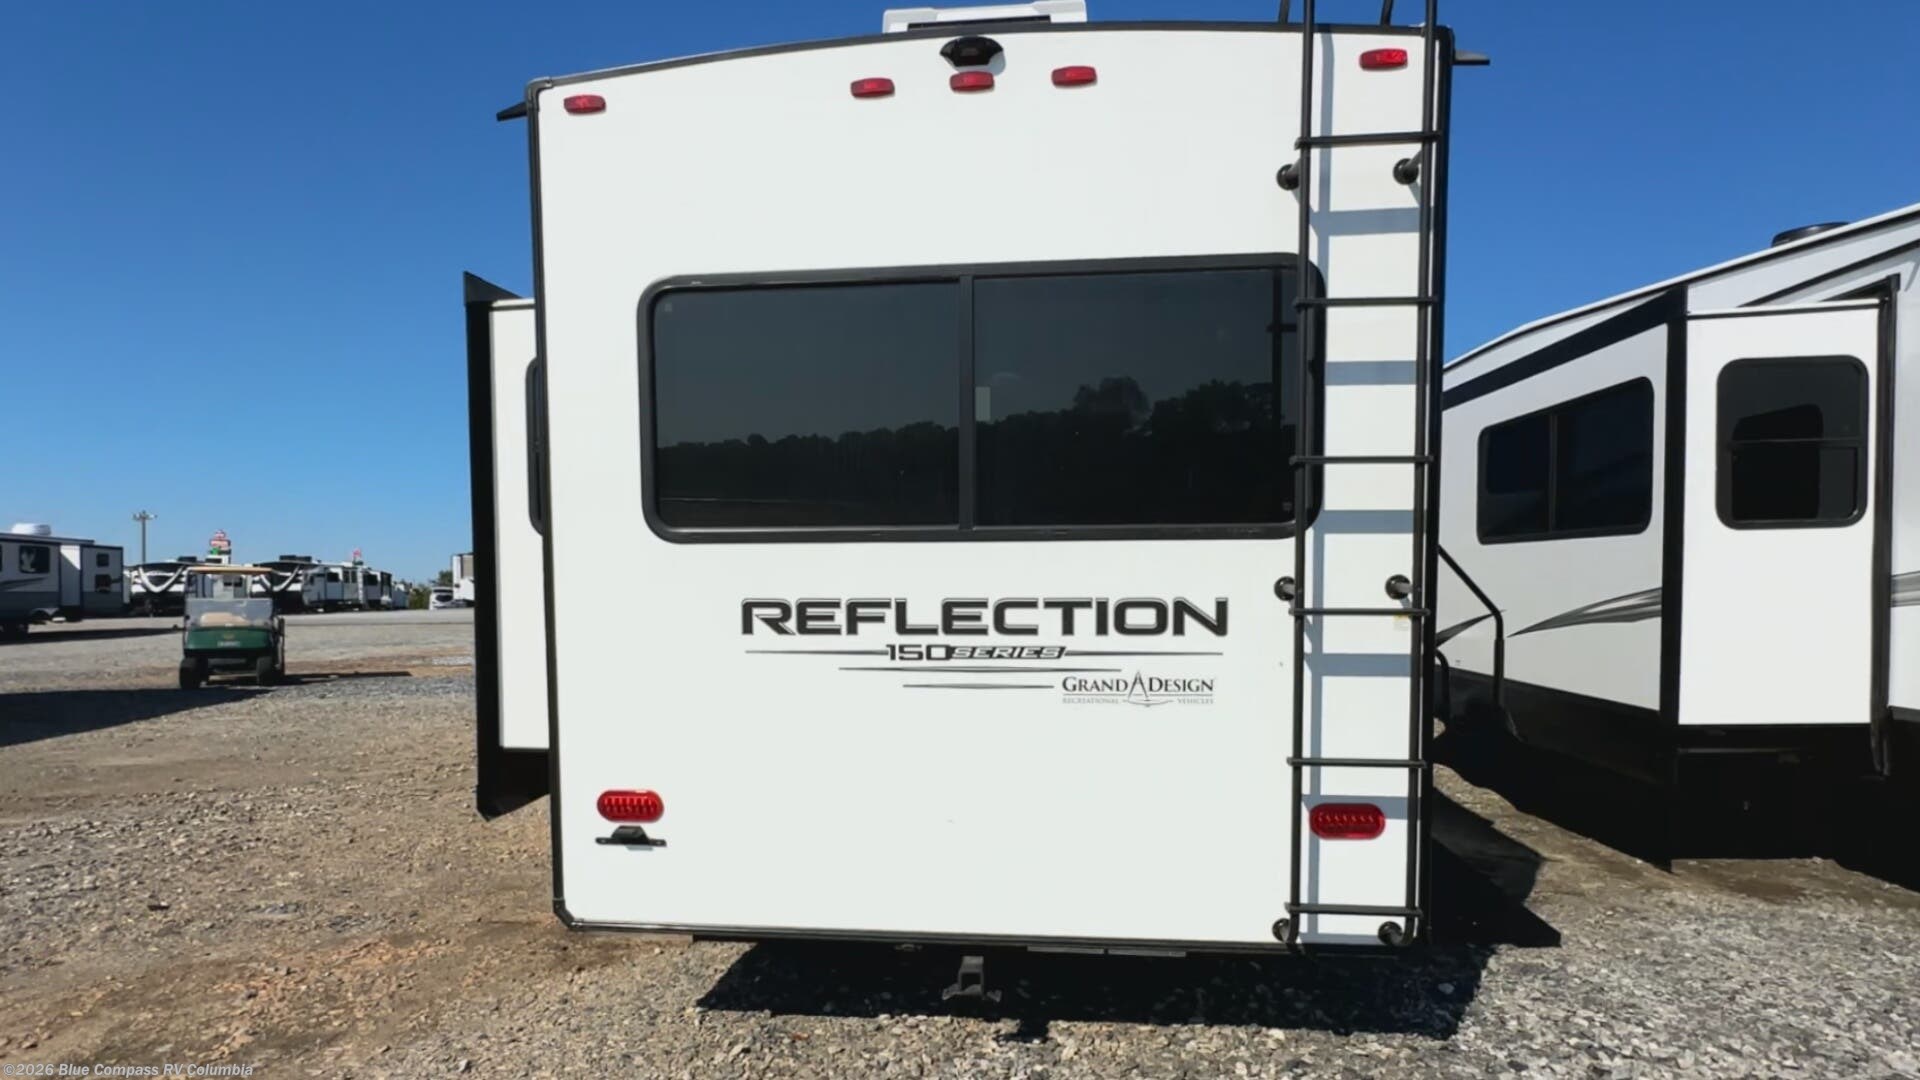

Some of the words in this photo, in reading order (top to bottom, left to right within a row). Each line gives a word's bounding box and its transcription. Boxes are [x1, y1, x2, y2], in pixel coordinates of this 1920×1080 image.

[741, 597, 1228, 636] REFLECTION
[886, 644, 950, 660] 150
[952, 646, 1066, 659] SERIES
[1062, 676, 1128, 693] GRAND
[1148, 677, 1214, 693] DESIGN
